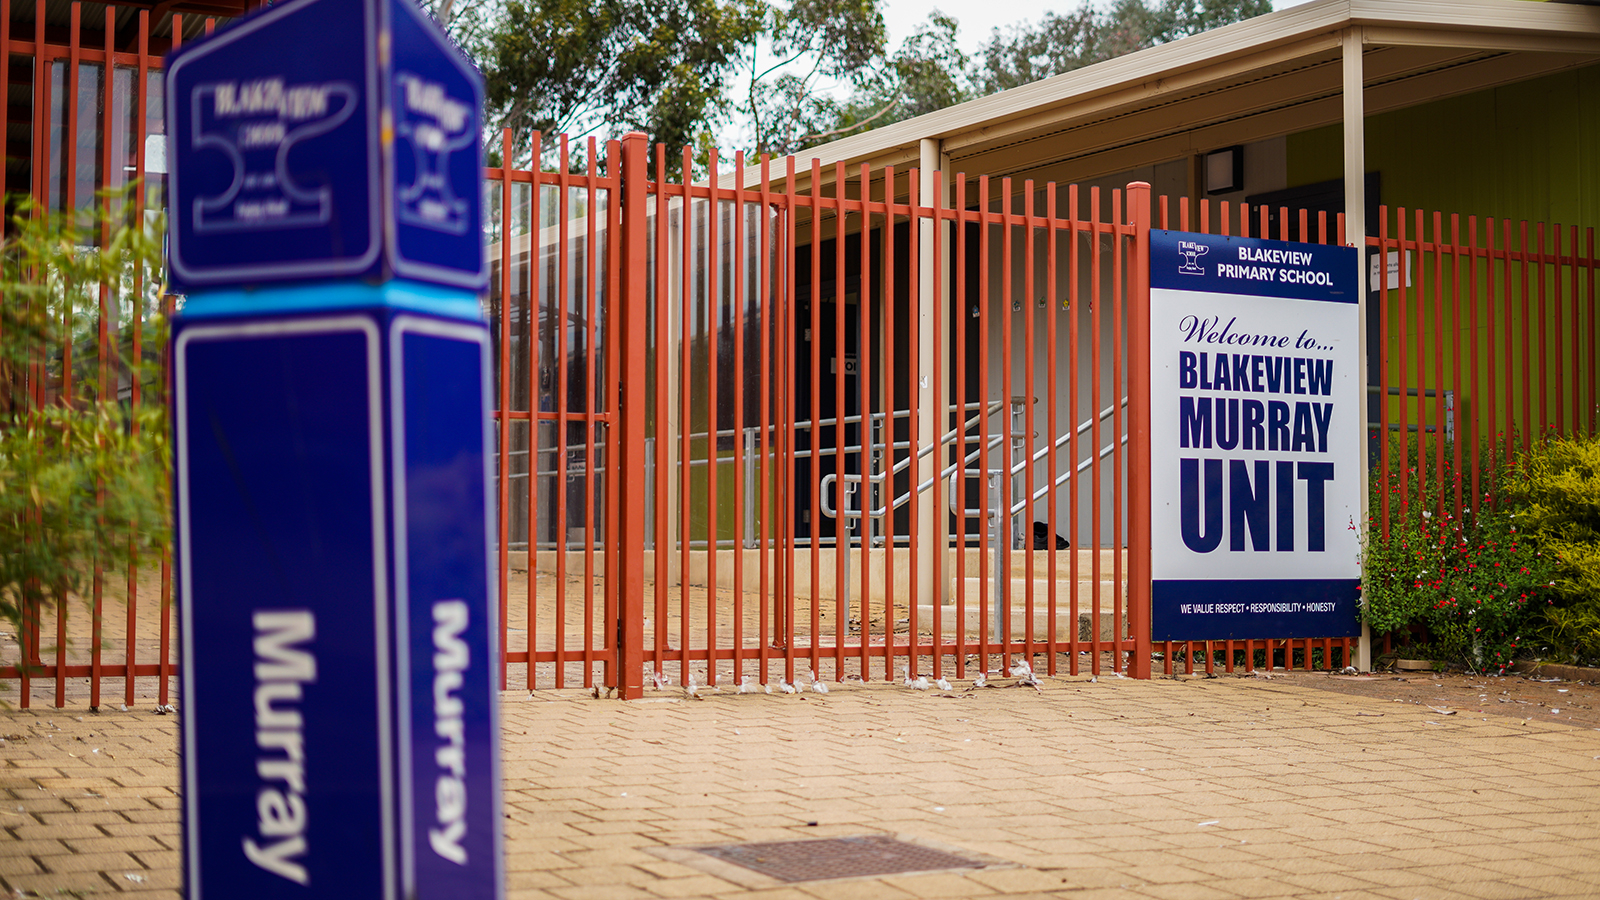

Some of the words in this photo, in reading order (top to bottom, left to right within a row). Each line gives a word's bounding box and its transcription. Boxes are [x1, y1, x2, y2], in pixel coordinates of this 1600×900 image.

[1217, 263, 1276, 282] PRIMARY
[1279, 269, 1333, 286] SCHOOL
[1238, 247, 1312, 266] BLAKEVIEW
[1179, 314, 1290, 349] Welcome
[1179, 351, 1333, 396] BLAKEVIEW
[1179, 396, 1334, 453] MURRAY
[1179, 457, 1335, 554] UNIT
[1180, 604, 1193, 614] WE
[1193, 604, 1214, 614] VALUE
[1215, 603, 1245, 613] RESPECT
[1250, 603, 1302, 613] RESPONSIBILITY
[1306, 602, 1336, 612] HONESTY
[244, 610, 316, 884] Murray
[429, 600, 470, 865] Murray
